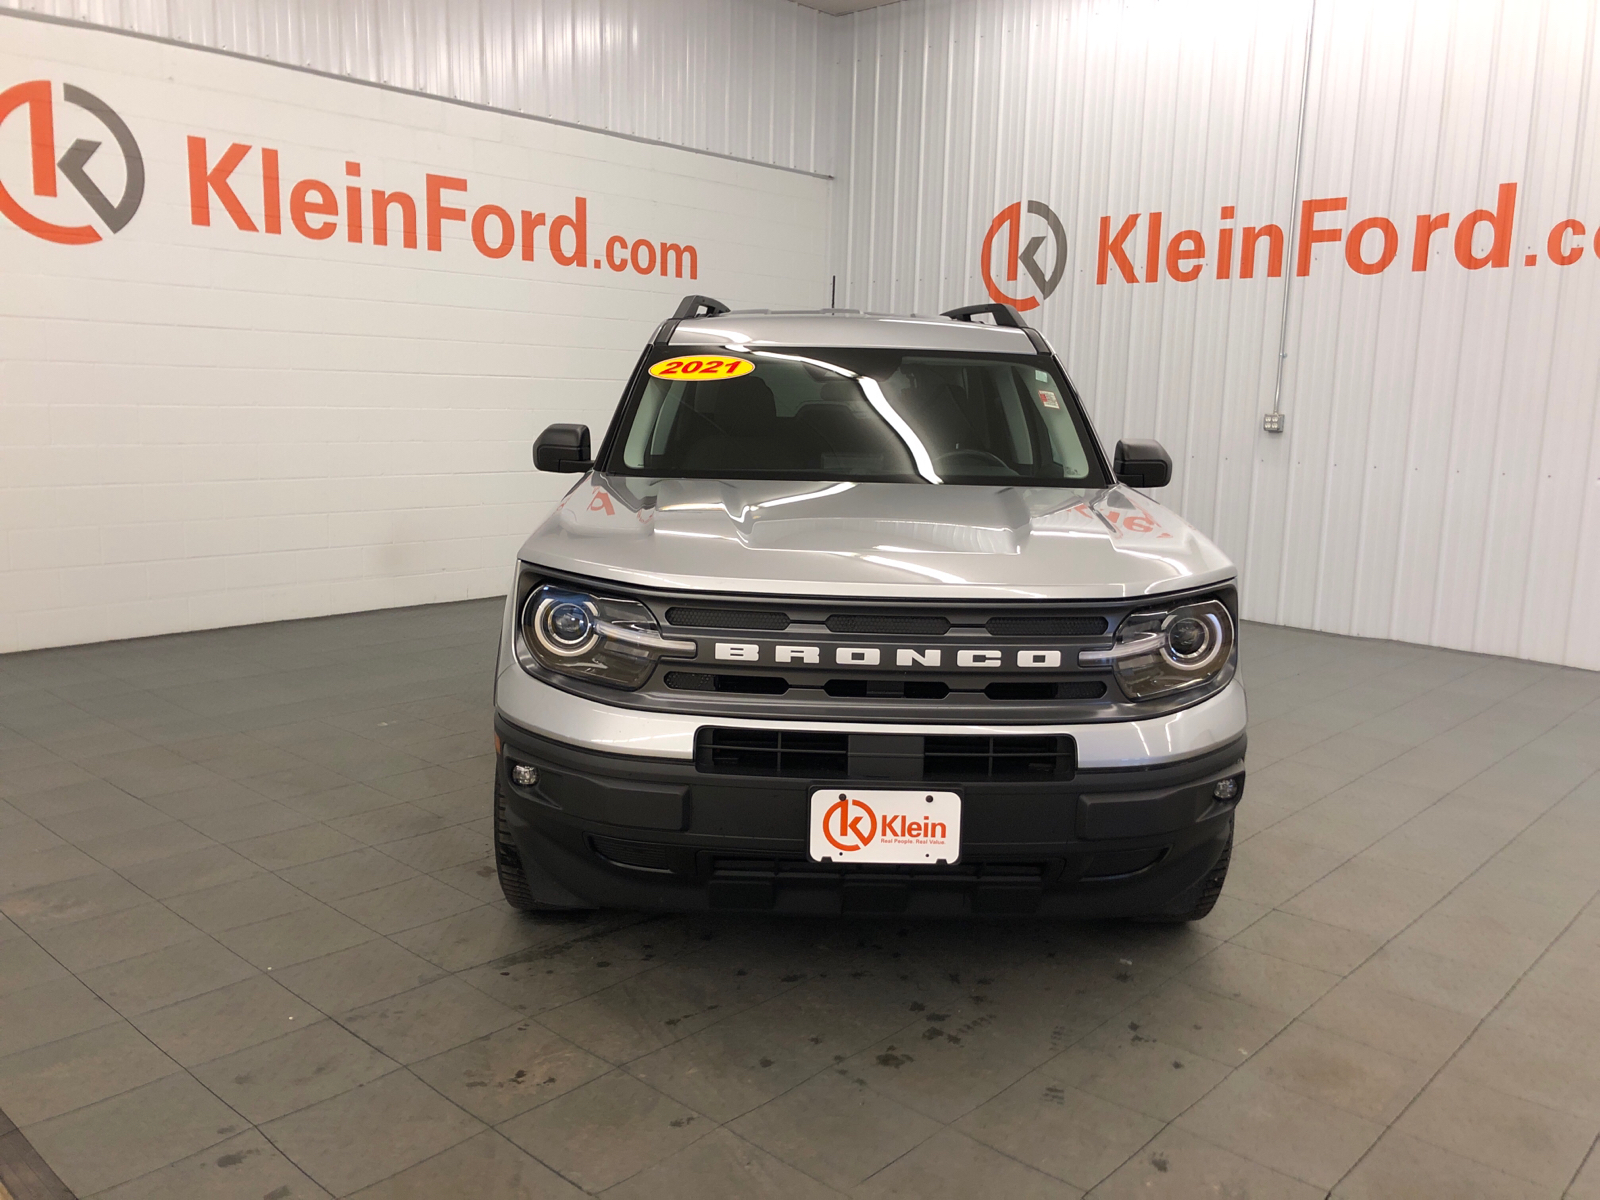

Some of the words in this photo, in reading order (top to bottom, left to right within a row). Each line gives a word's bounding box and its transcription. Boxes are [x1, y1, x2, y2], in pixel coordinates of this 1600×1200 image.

[187, 135, 698, 281] KleinFord.com
[1097, 182, 1600, 285] KleinFord.c
[658, 360, 742, 375] 2021
[714, 642, 1062, 668] BRONCO
[881, 814, 947, 839] Klein
